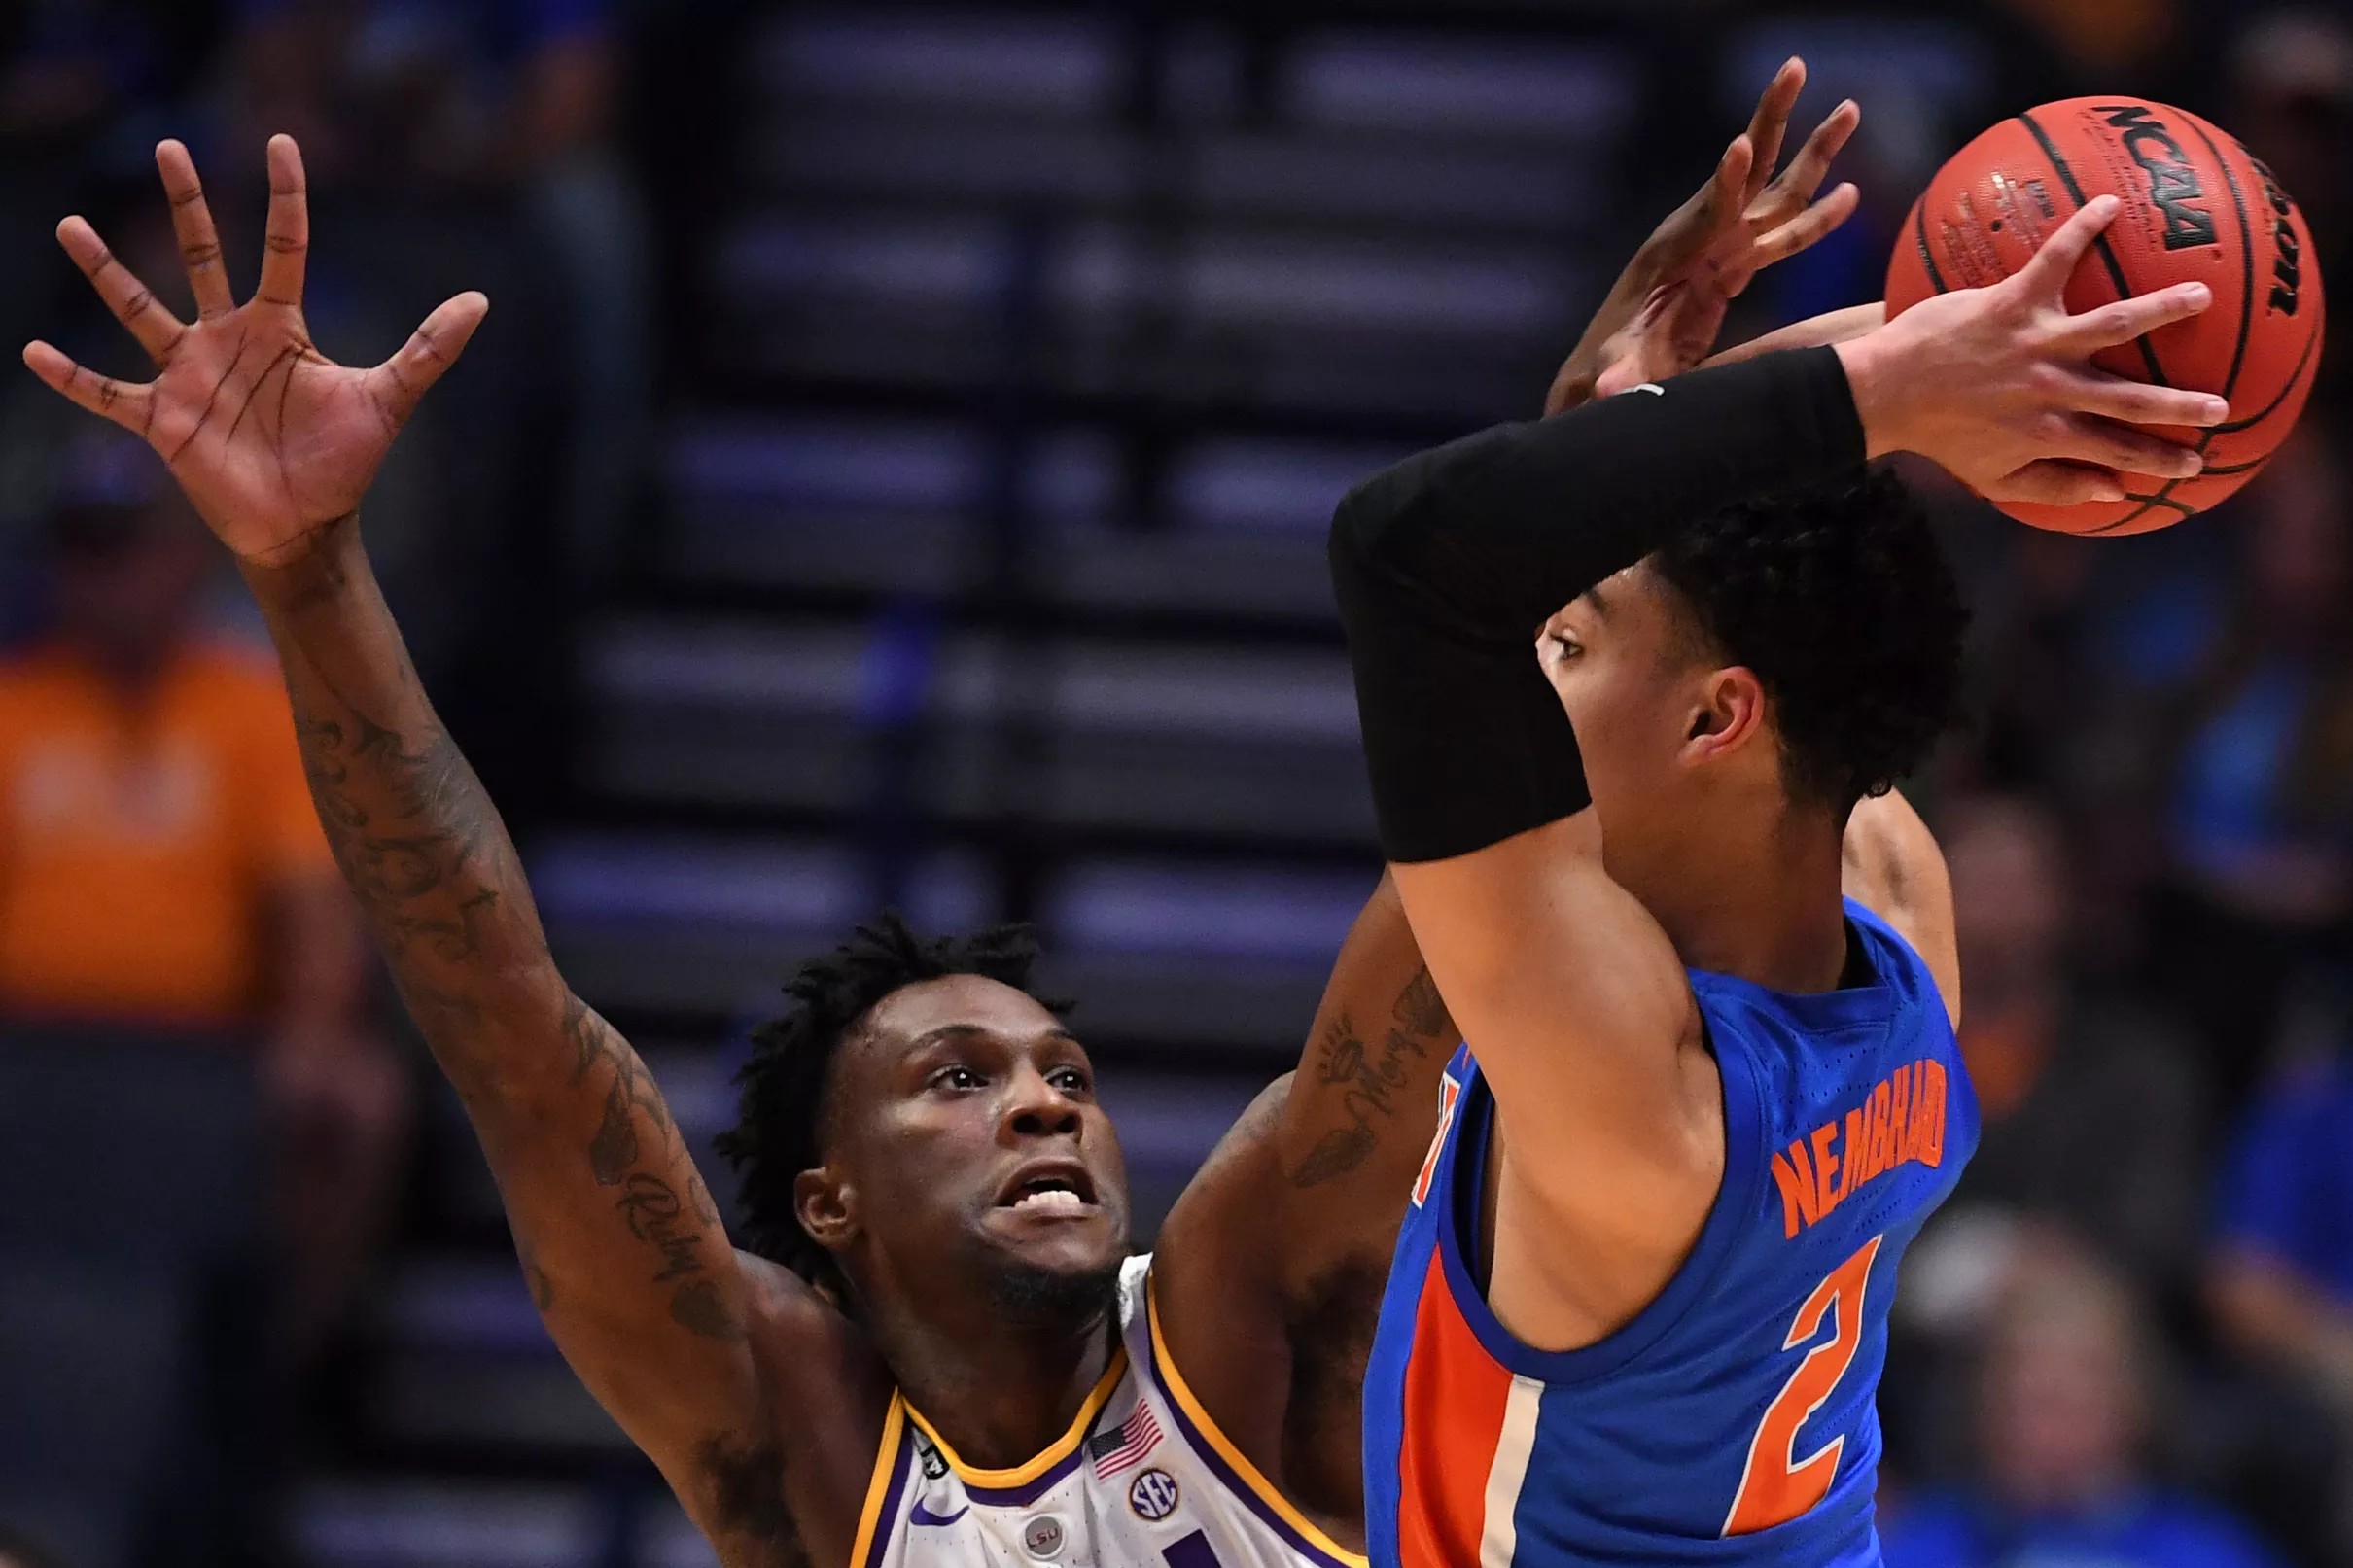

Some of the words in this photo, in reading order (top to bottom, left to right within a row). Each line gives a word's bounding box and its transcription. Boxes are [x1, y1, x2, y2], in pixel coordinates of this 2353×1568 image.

[2089, 105, 2218, 251] NCAA
[1721, 1234, 1883, 1539] 2
[1026, 1527, 1060, 1548] LSU
[1132, 1470, 1177, 1518] SEC
